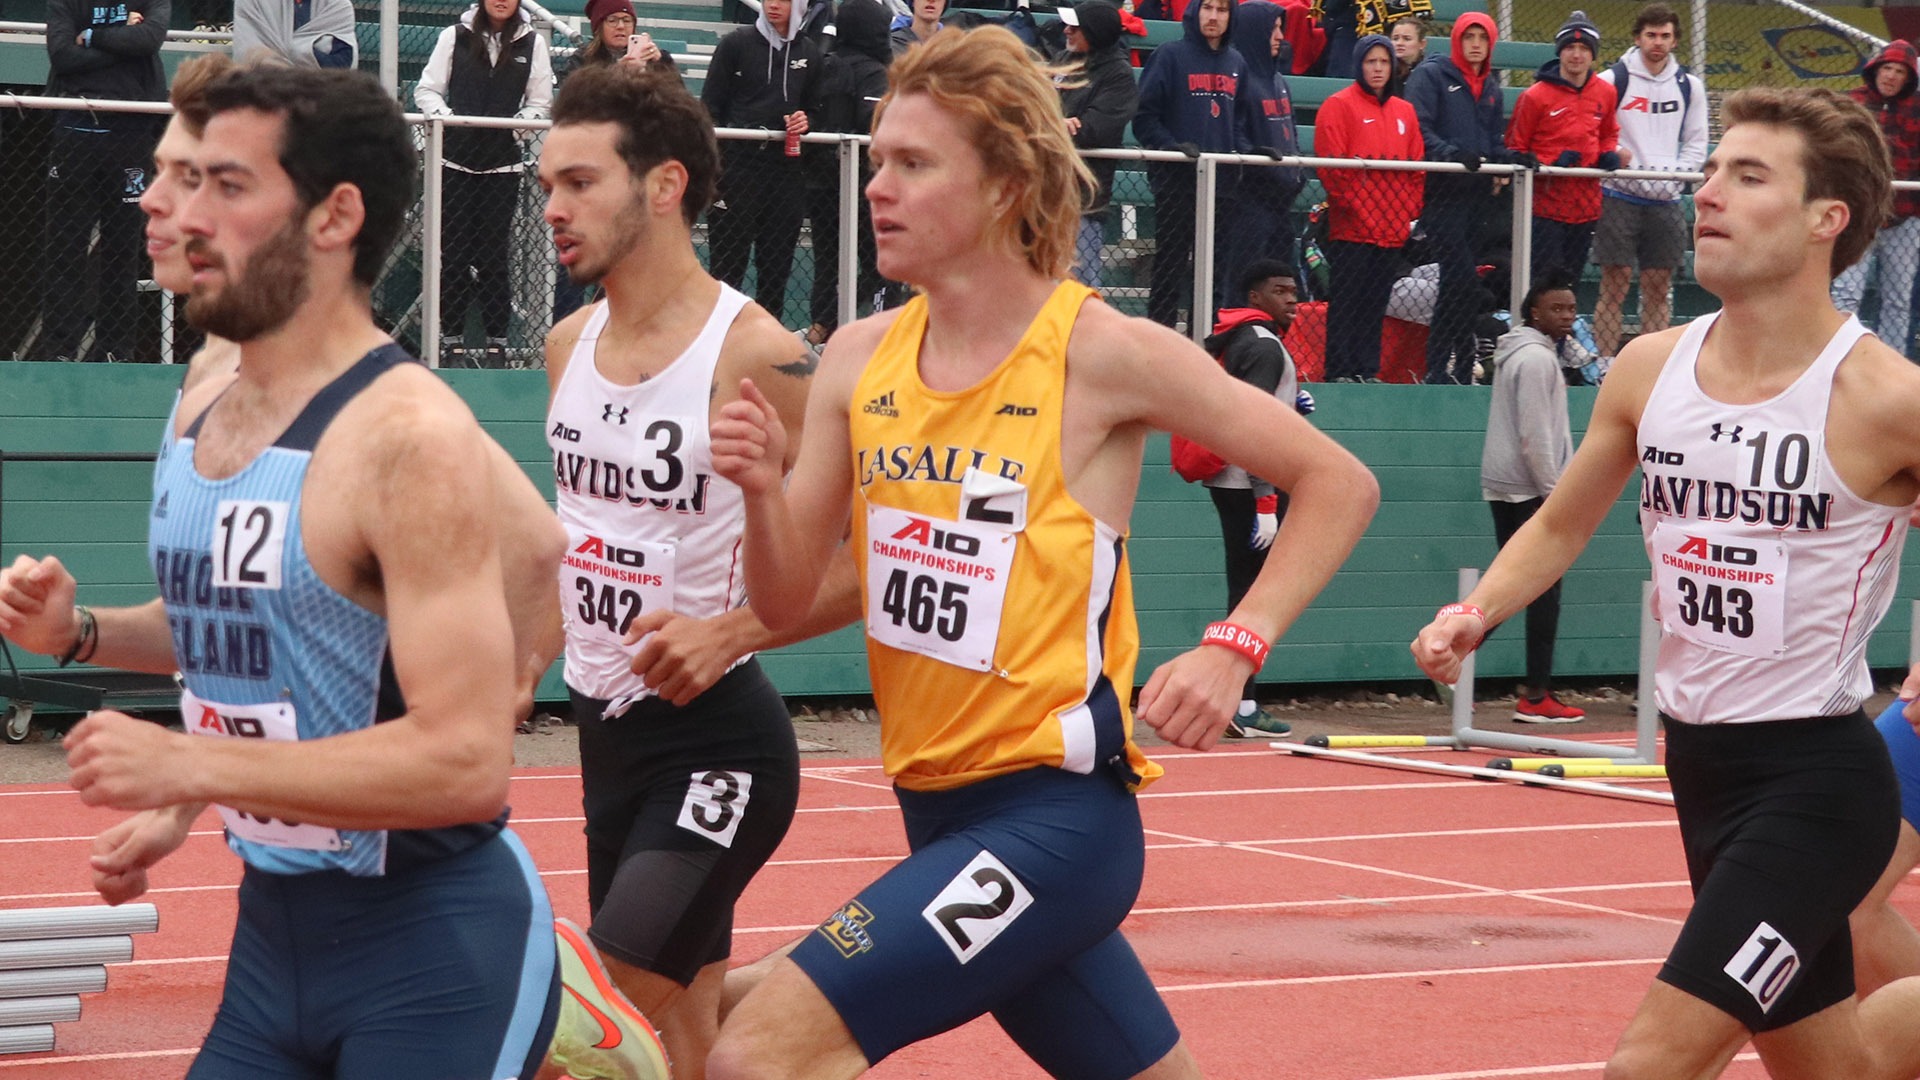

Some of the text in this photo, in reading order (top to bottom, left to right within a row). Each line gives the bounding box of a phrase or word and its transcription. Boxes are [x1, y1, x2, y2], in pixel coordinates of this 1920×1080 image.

[863, 404, 899, 418] adidas
[995, 404, 1038, 416] A10
[552, 422, 582, 443] A10
[641, 419, 684, 493] 3
[1642, 445, 1684, 466] A10
[1746, 430, 1810, 491] 10
[221, 505, 273, 583] 12
[575, 534, 645, 568] A10
[891, 516, 981, 557] A10
[1676, 534, 1758, 566] A10
[873, 540, 996, 581] CHAMPIONSHIPS
[1662, 553, 1775, 585] CHAMPIONSHIPS
[575, 576, 643, 636] 342
[882, 568, 970, 642] 465
[1677, 576, 1755, 639] 343
[199, 703, 267, 739] A10
[692, 770, 739, 833] 3
[934, 867, 1015, 952] 2
[1740, 935, 1796, 1005] 10
